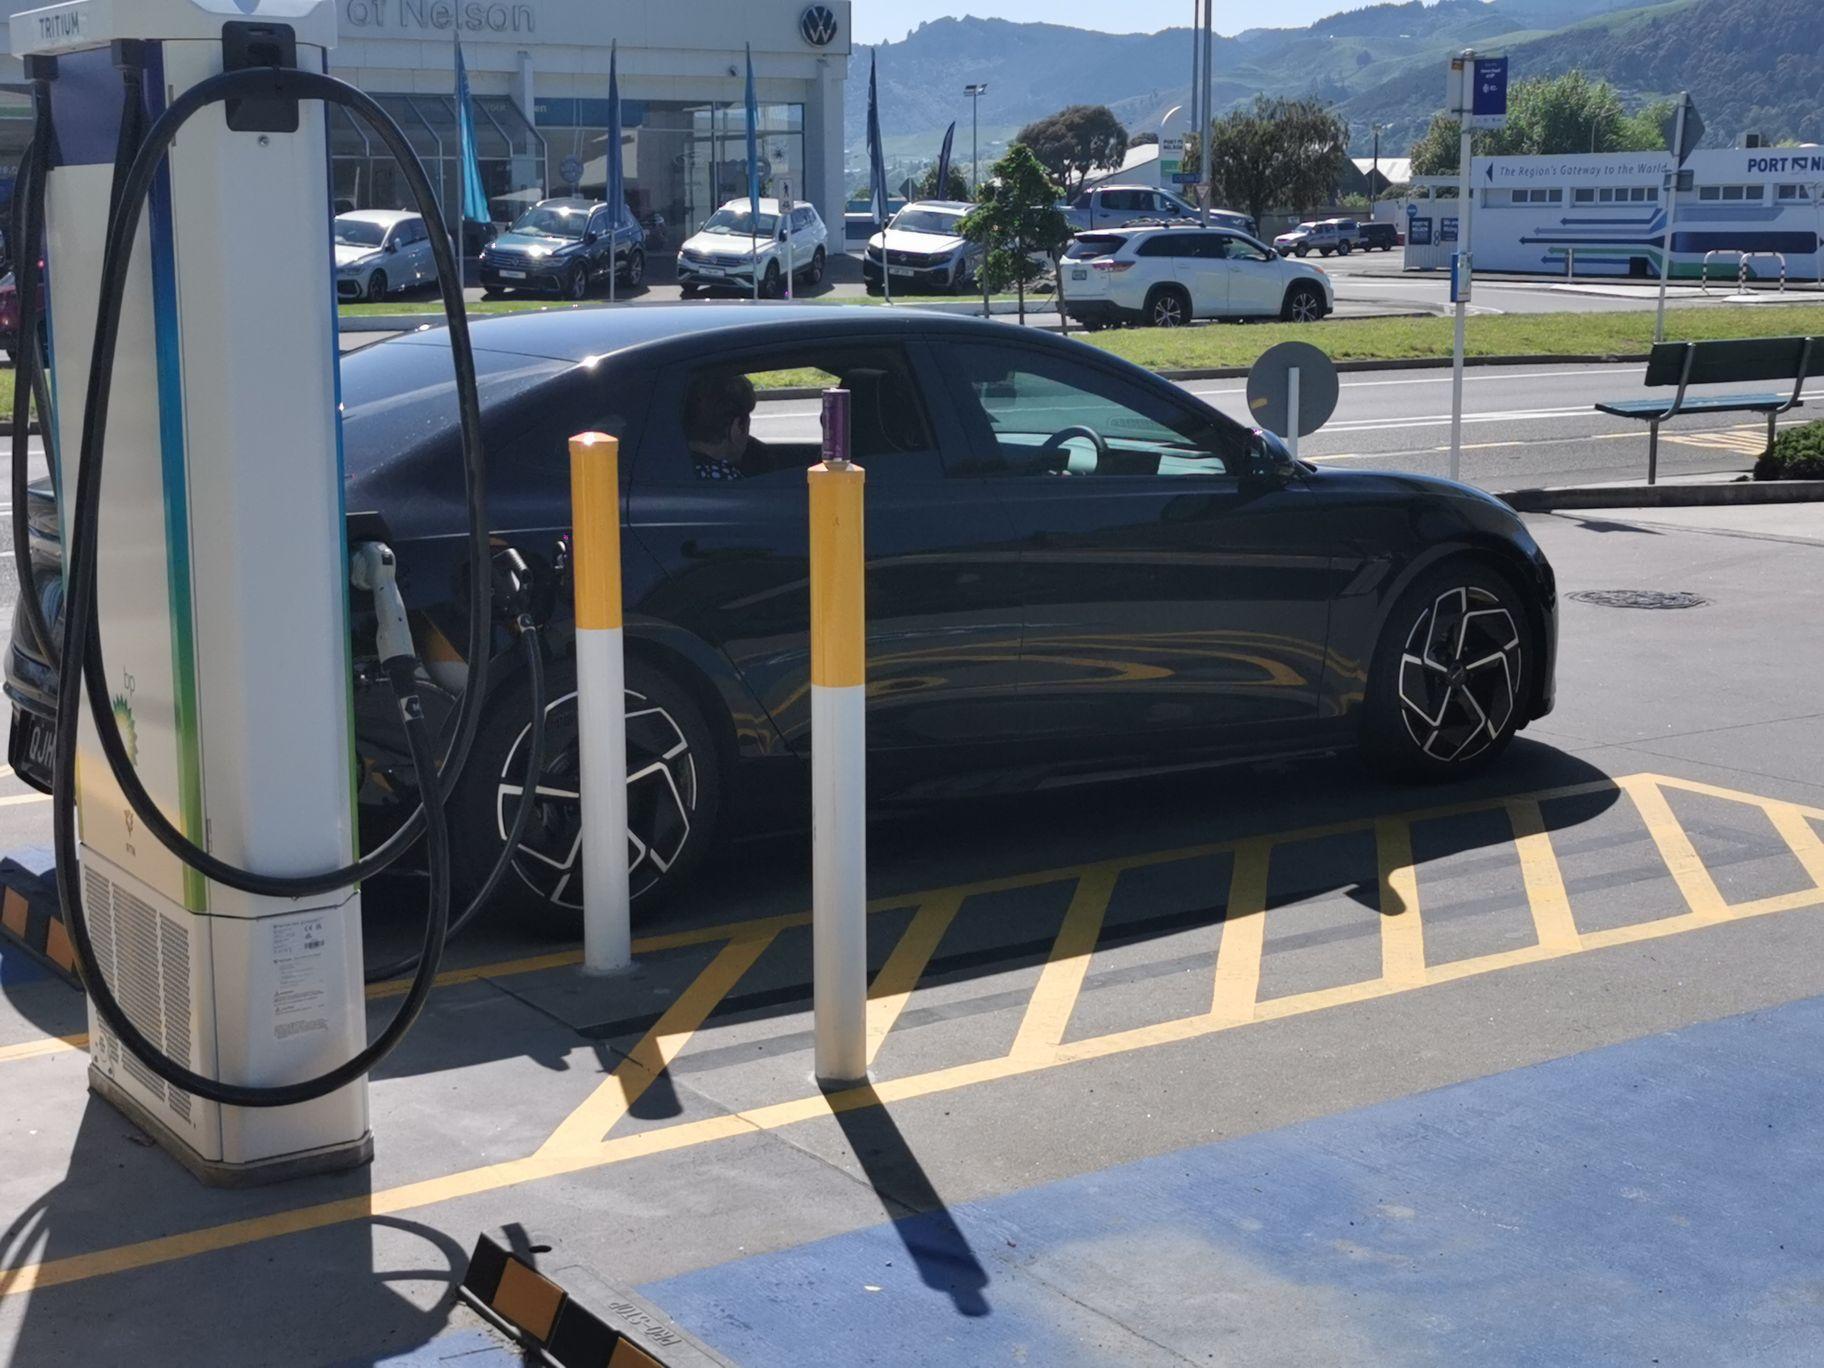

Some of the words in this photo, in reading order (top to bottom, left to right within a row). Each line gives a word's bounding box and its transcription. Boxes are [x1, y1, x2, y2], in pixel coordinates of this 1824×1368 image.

[39, 11, 80, 40] TRITIUM
[400, 0, 535, 33] Nelson
[1500, 166, 1515, 177] The
[1518, 166, 1557, 178] Region's
[1560, 164, 1601, 177] Gateway
[1604, 164, 1615, 175] to
[1618, 163, 1634, 174] the
[1638, 162, 1668, 174] World
[1748, 157, 1789, 173] PORT
[1810, 156, 1824, 171] N
[123, 664, 136, 697] bp
[608, 1302, 682, 1347] PRO-STOP
